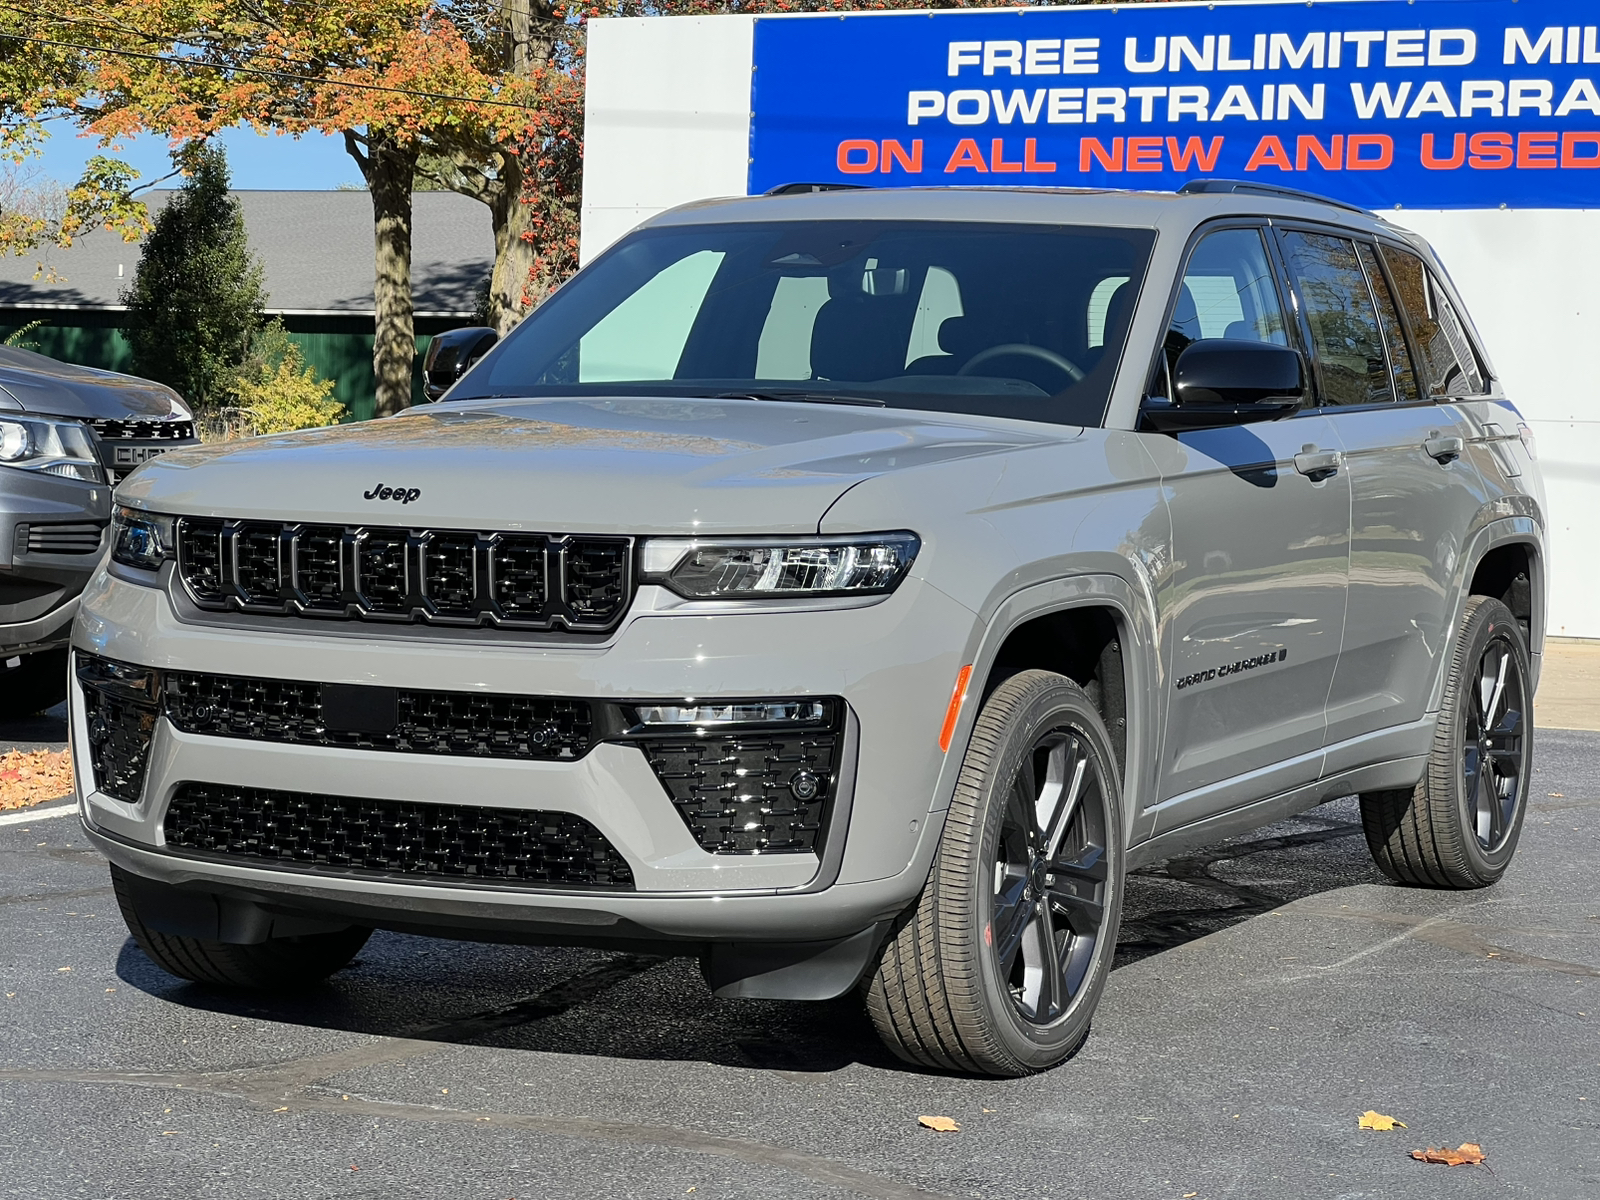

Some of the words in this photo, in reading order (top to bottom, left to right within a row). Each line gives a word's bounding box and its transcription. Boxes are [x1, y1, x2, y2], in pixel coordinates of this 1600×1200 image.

[947, 38, 1101, 78] FREE
[1122, 28, 1477, 75] UNLIMITED
[907, 82, 1326, 126] POWERTRAIN
[1349, 78, 1600, 120] WARRA
[836, 138, 924, 175] ON
[943, 136, 1057, 174] ALL
[1078, 135, 1225, 173] NEW
[1243, 132, 1395, 173] AND
[1419, 130, 1600, 171] USED
[363, 482, 421, 505] Jeep
[1175, 668, 1217, 690] GRAND
[1217, 651, 1278, 678] CHEROKEE
